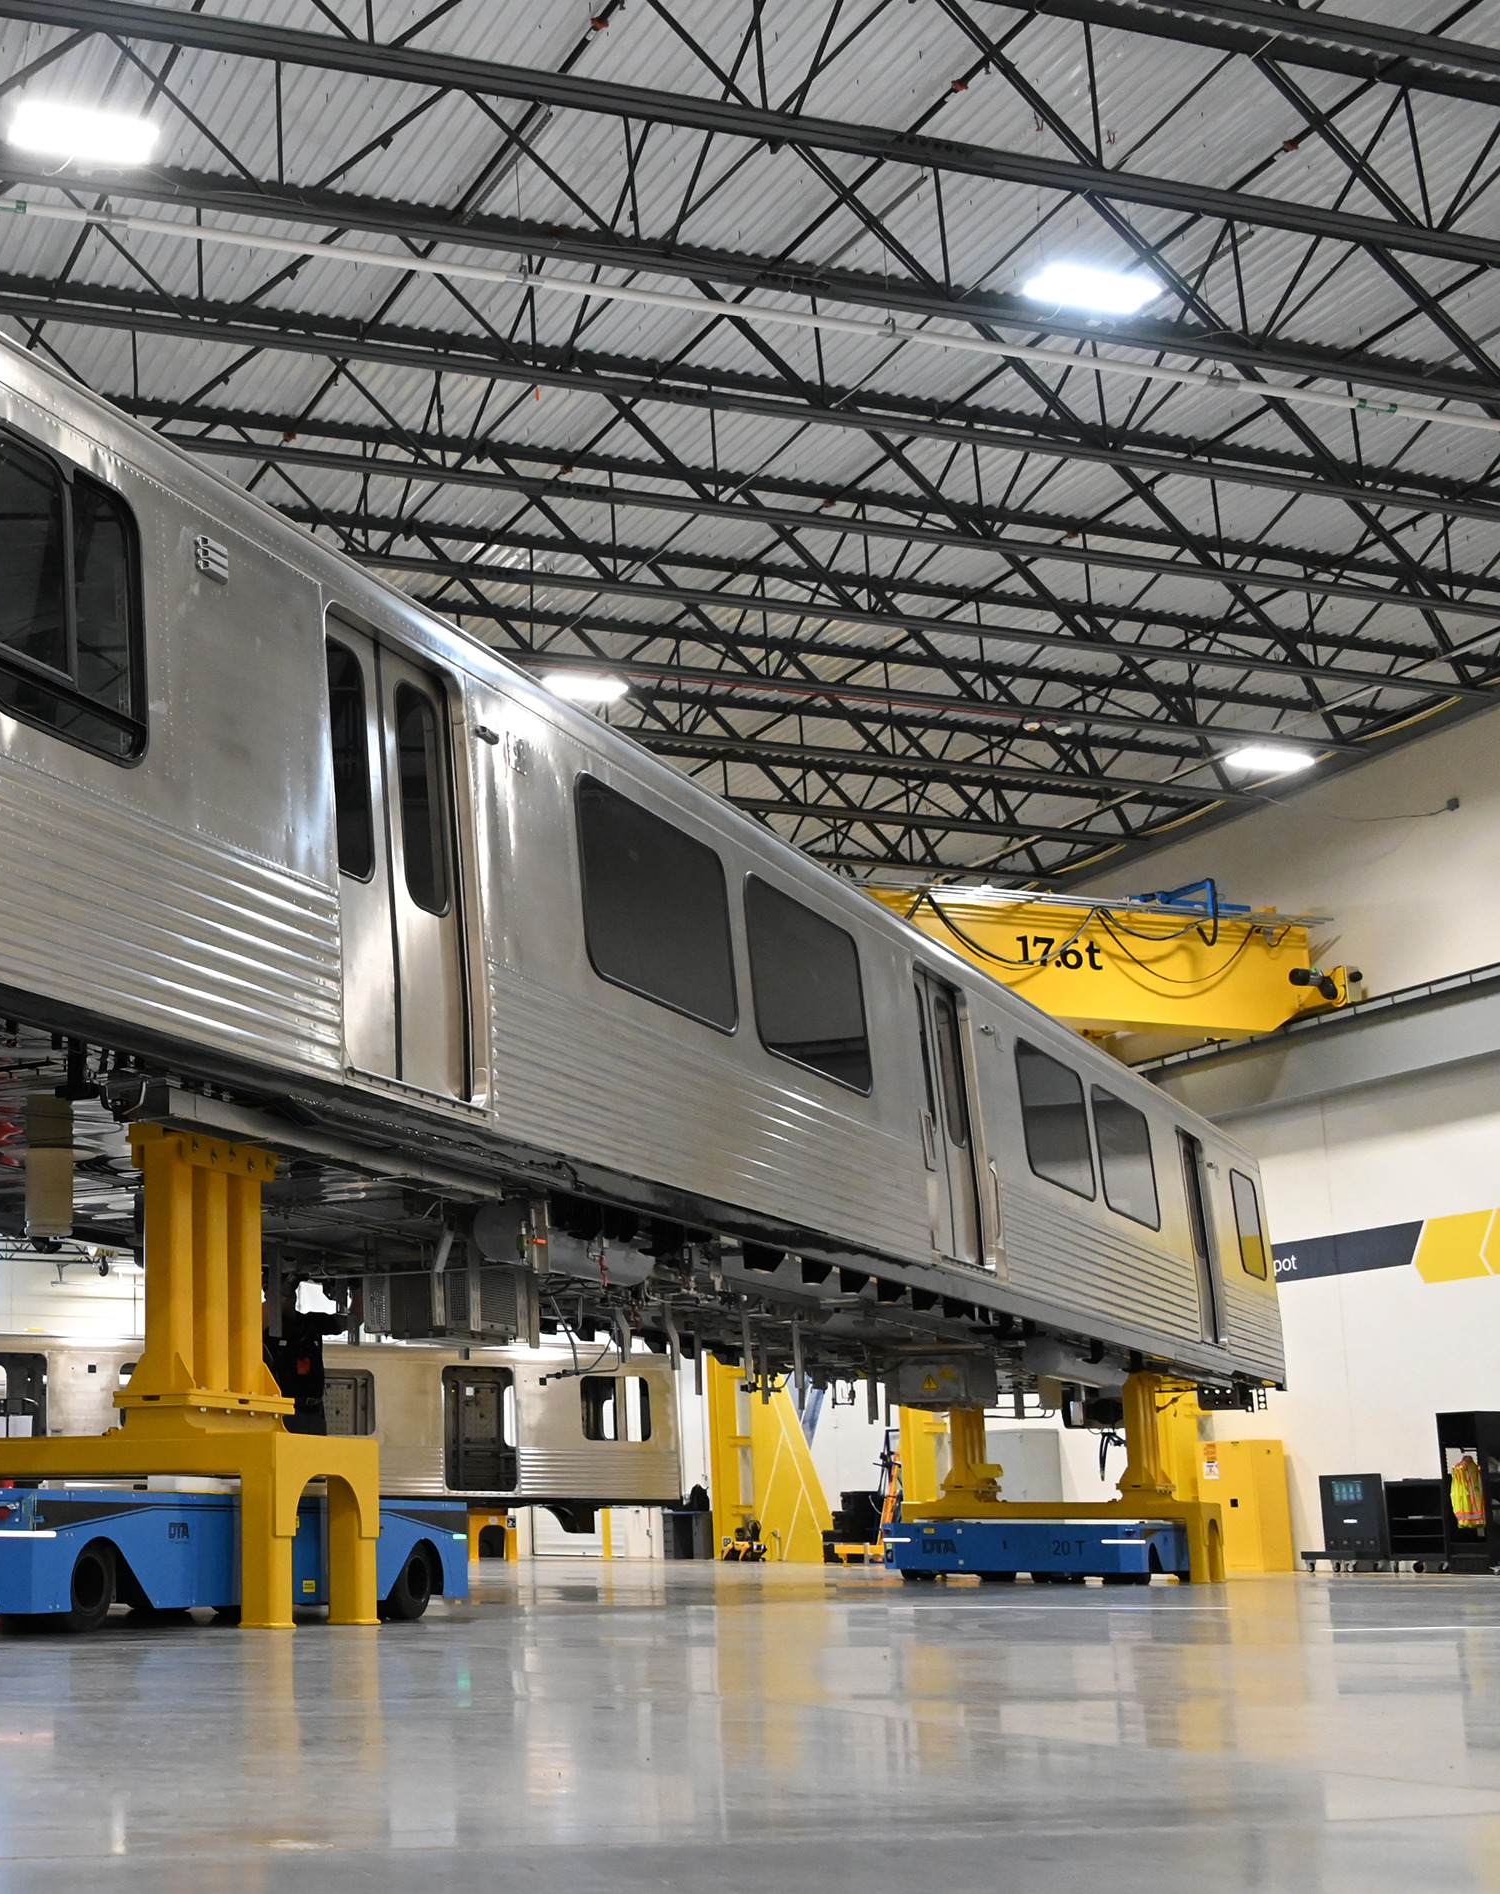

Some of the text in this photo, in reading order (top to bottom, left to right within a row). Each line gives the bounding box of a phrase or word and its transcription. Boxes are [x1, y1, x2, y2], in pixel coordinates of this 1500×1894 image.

[1016, 935, 1103, 970] 17.6t
[168, 1522, 190, 1539] DTA
[922, 1538, 957, 1555] DTA
[1052, 1540, 1085, 1556] 20 T
